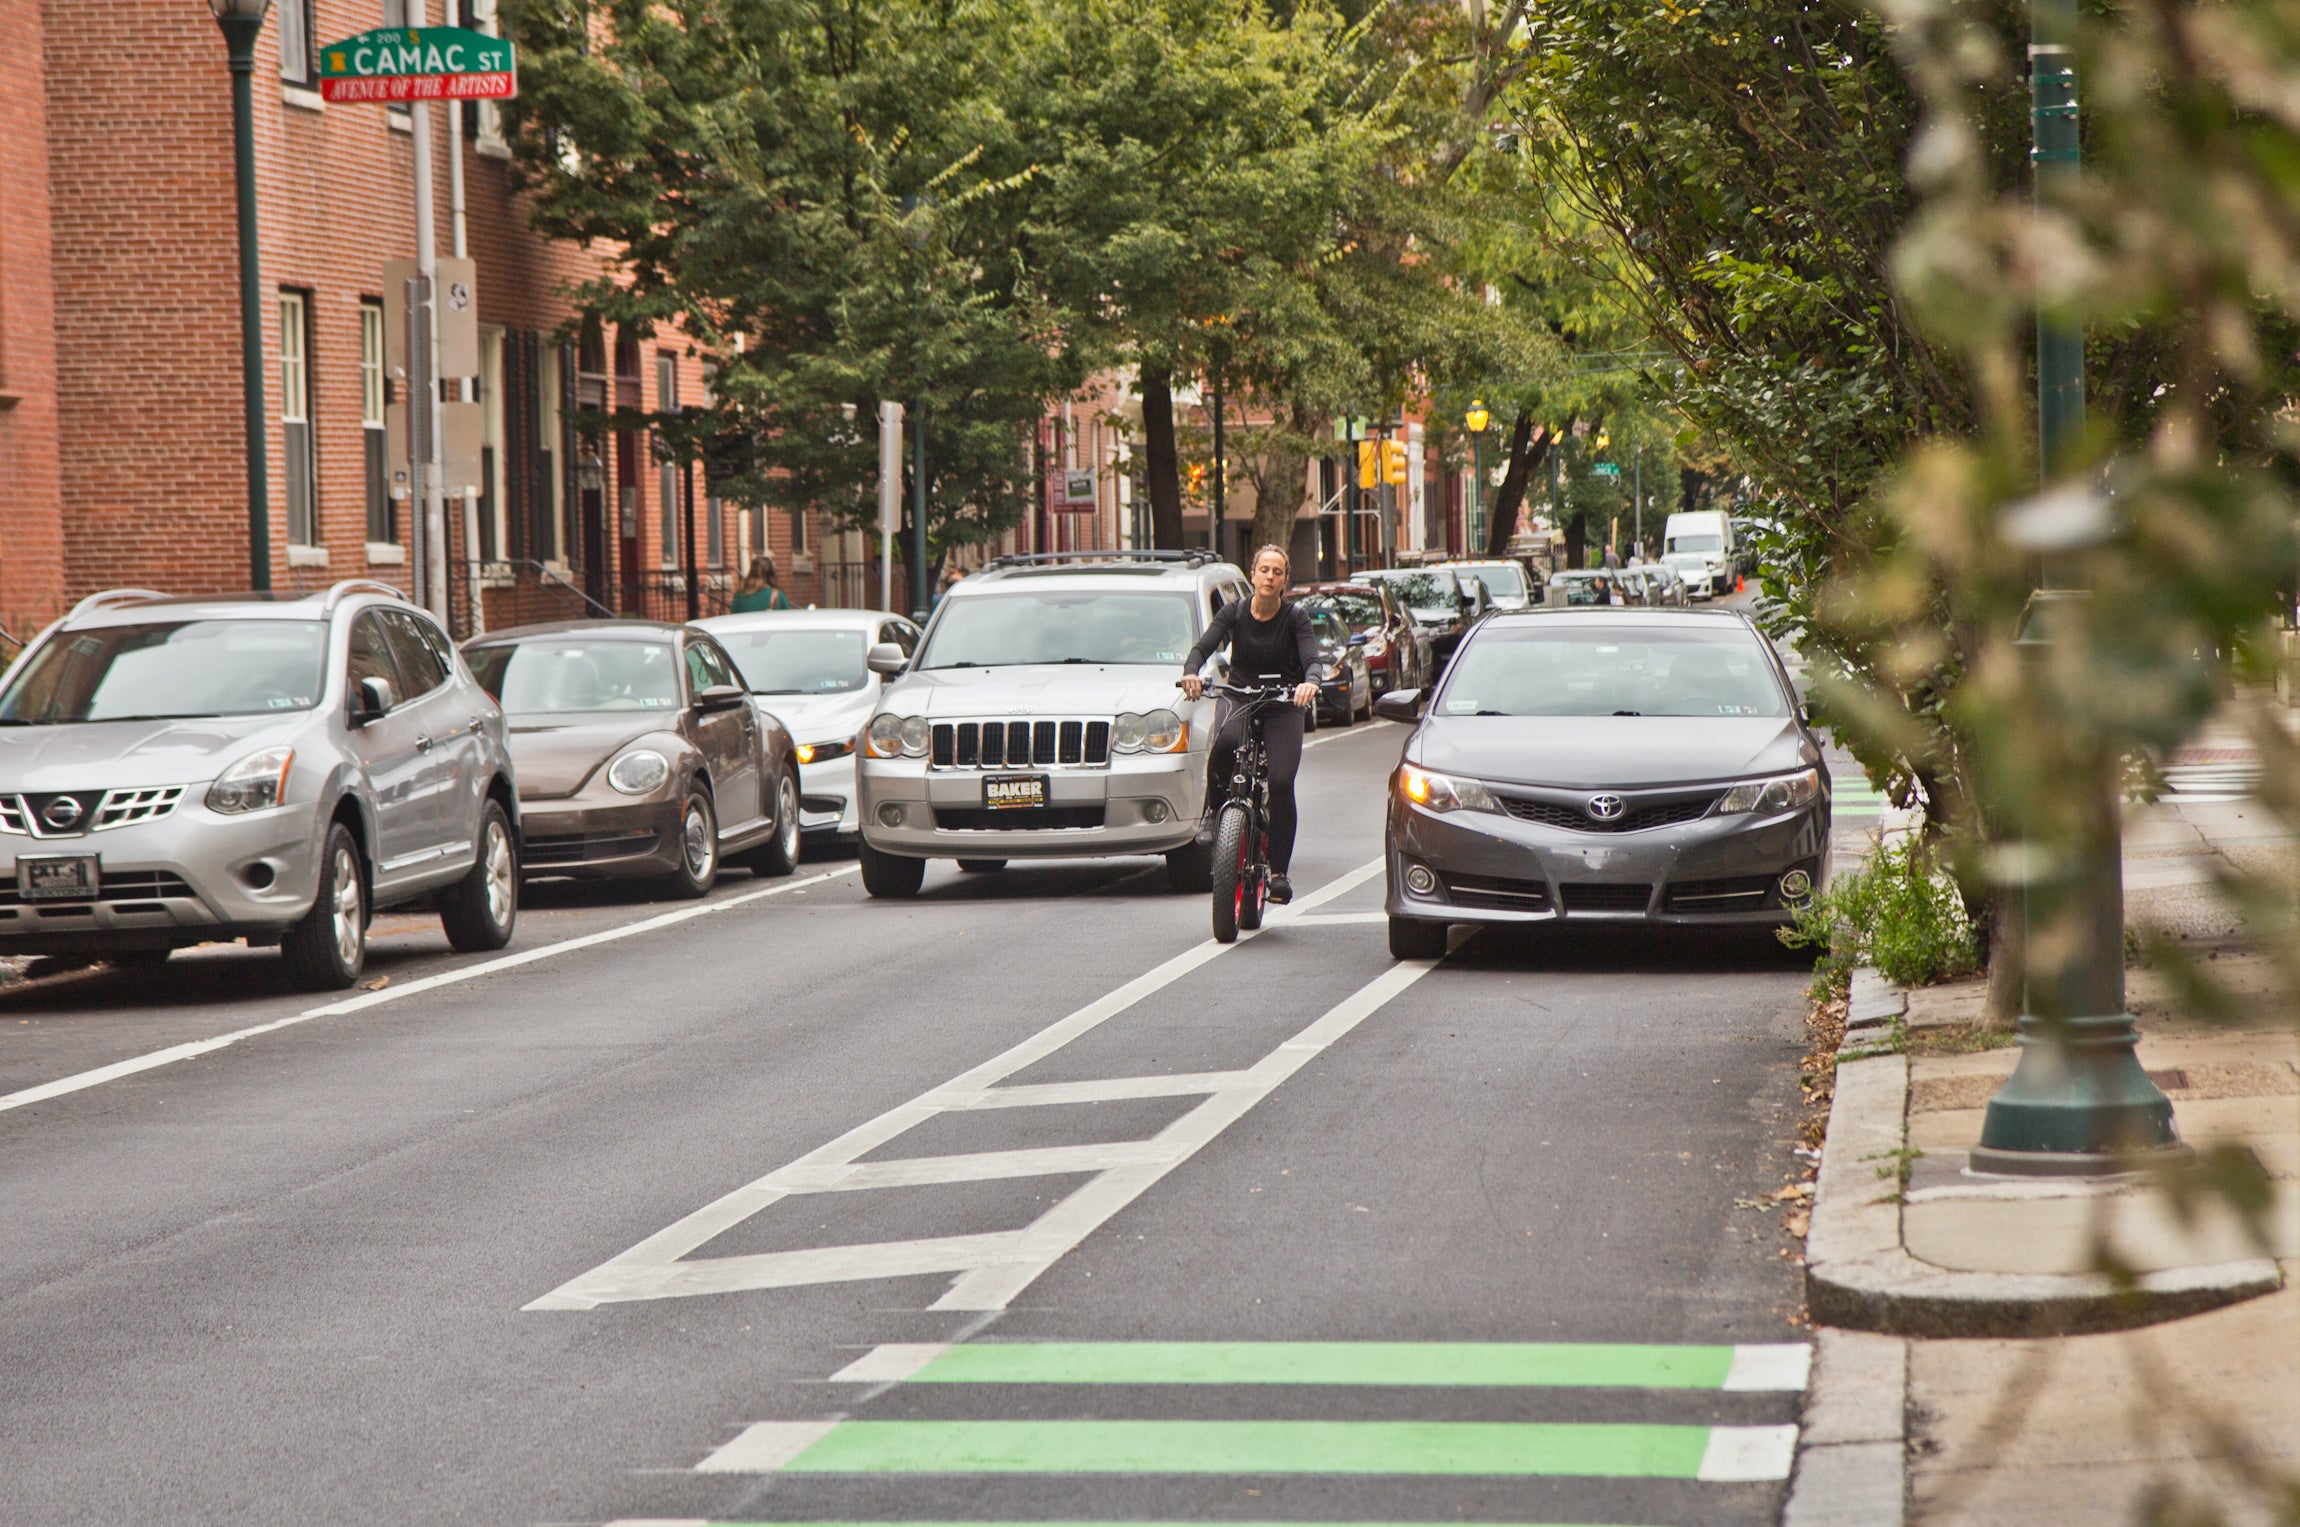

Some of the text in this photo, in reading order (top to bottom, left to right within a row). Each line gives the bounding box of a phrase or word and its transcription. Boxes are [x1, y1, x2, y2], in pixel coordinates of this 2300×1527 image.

[377, 30, 420, 46] 200 S
[354, 44, 503, 75] CAMAC ST
[331, 76, 507, 99] AVENUE OF THE ARTISTS
[987, 781, 1042, 797] BAKER
